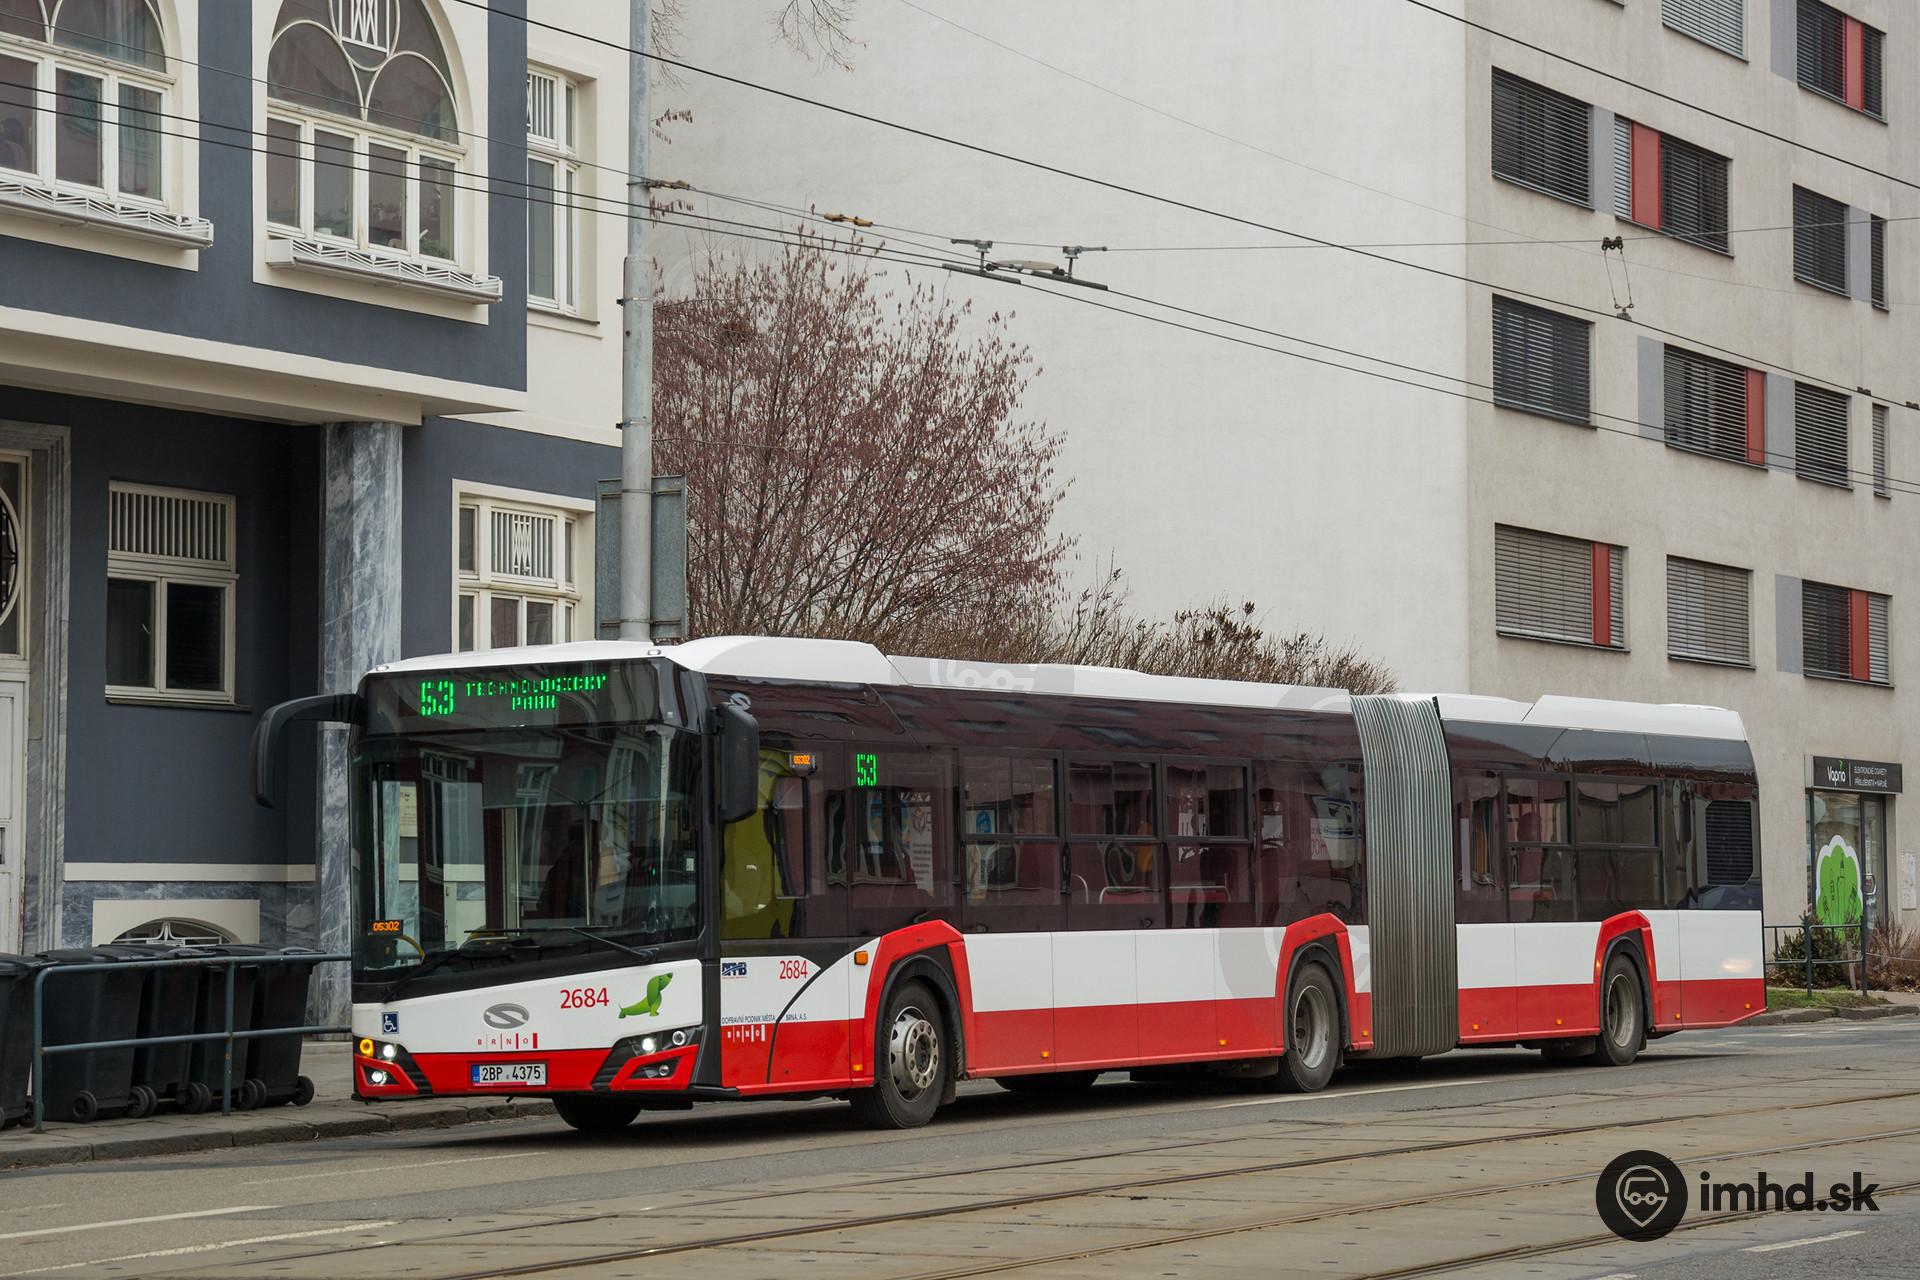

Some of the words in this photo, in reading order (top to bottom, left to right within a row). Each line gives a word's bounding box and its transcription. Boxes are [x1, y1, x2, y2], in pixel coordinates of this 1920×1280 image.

[420, 680, 454, 717] 53
[856, 752, 878, 787] 53
[372, 921, 400, 932] 05302
[779, 959, 808, 980] 2684
[560, 987, 610, 1009] 2684
[482, 1066, 503, 1081] 2BP
[512, 1065, 541, 1081] 4375
